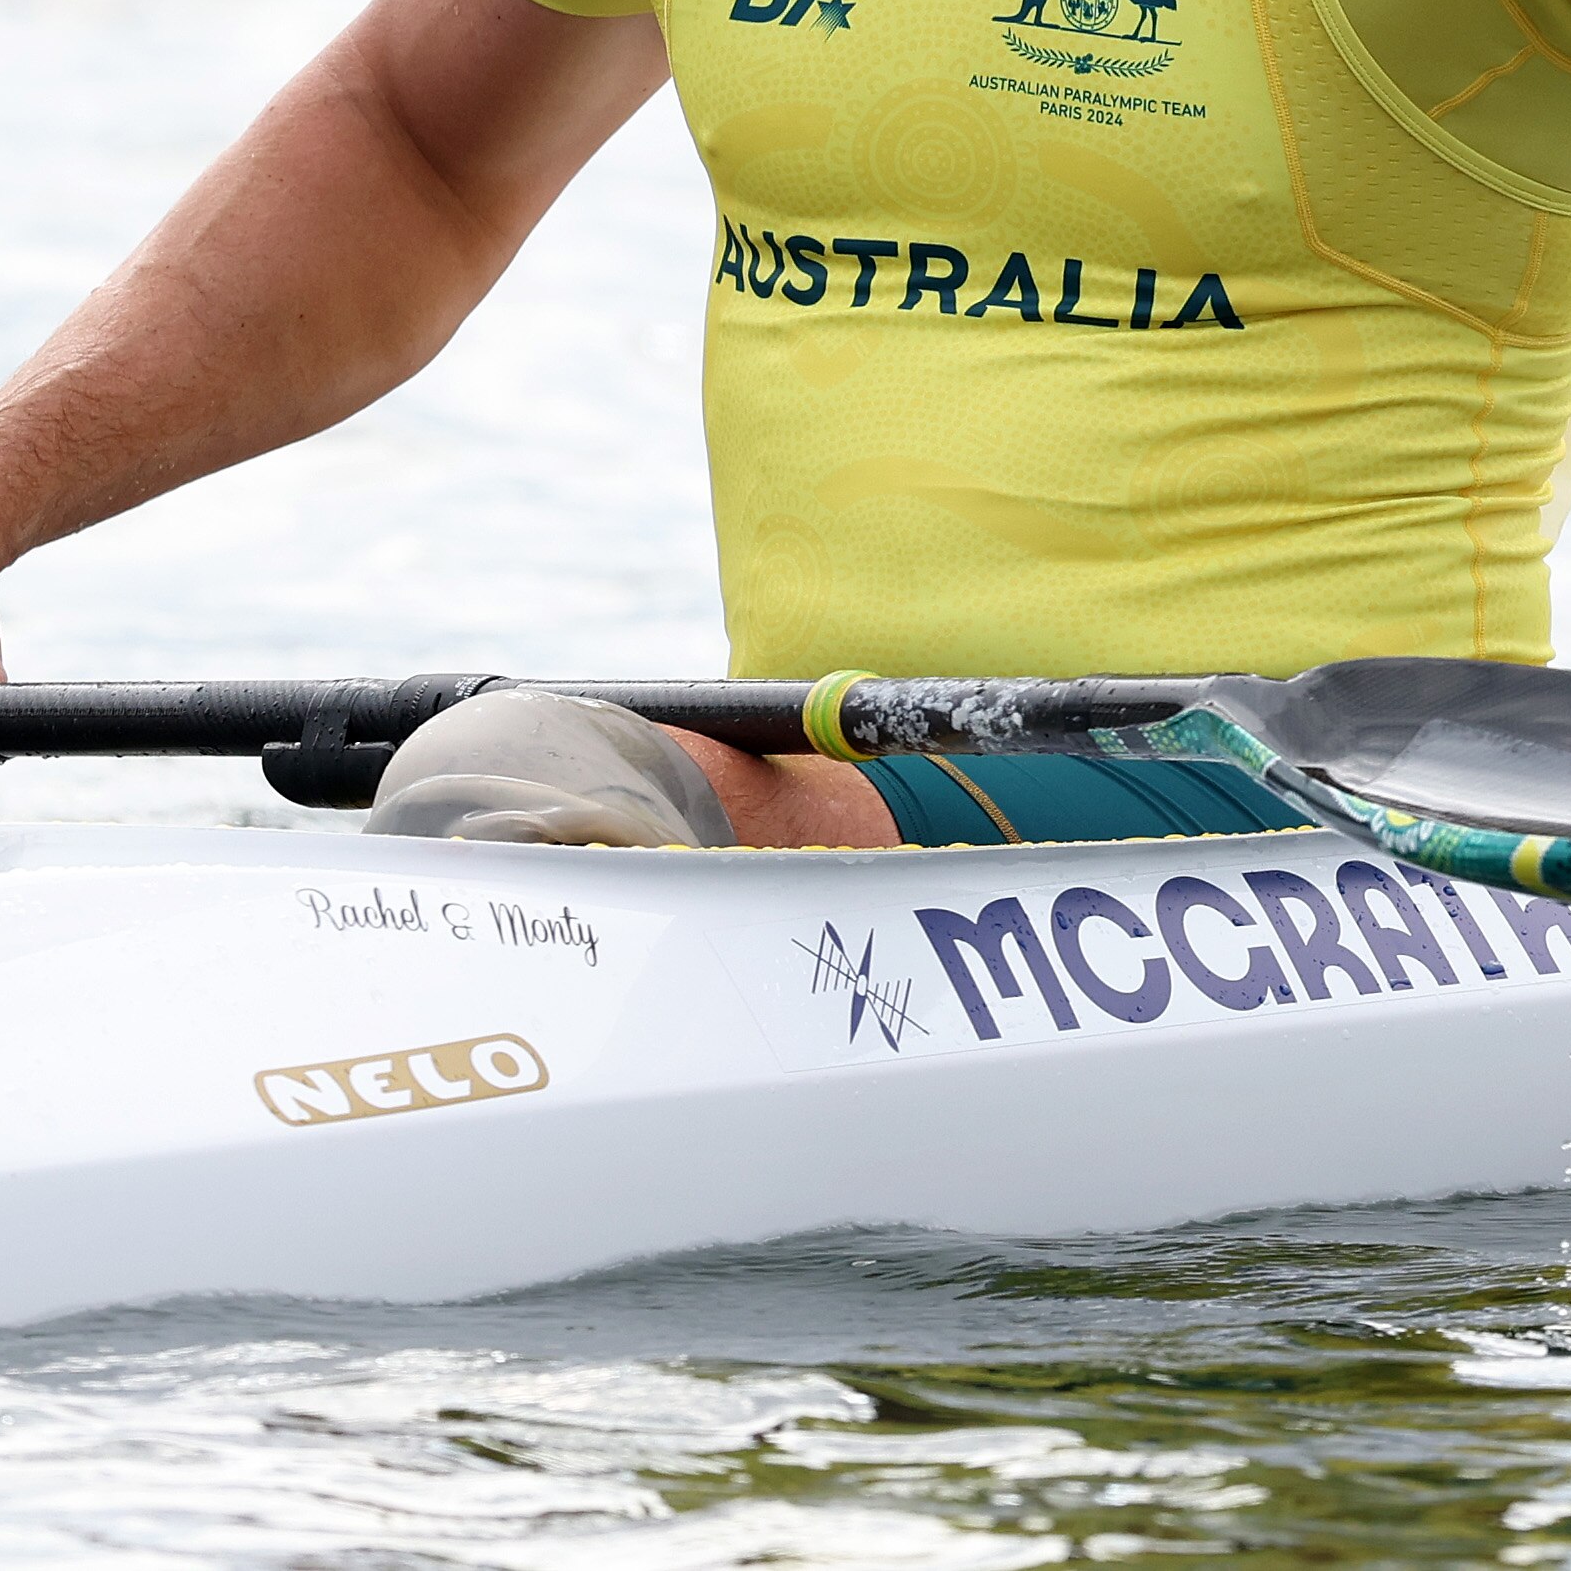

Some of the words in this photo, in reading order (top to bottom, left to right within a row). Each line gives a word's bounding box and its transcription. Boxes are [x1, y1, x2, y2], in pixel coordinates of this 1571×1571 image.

[968, 75, 1060, 99] AUSTRALIAN
[1064, 87, 1158, 113] PARALYMPIC
[1161, 100, 1206, 118] TEAM
[1040, 101, 1082, 120] PARIS
[1086, 108, 1124, 127] 2024
[715, 214, 1245, 330] AUSTRALIA
[296, 888, 428, 931] Rachel
[441, 902, 474, 940] &
[489, 901, 599, 967] Monty
[263, 1039, 540, 1121] NELO
